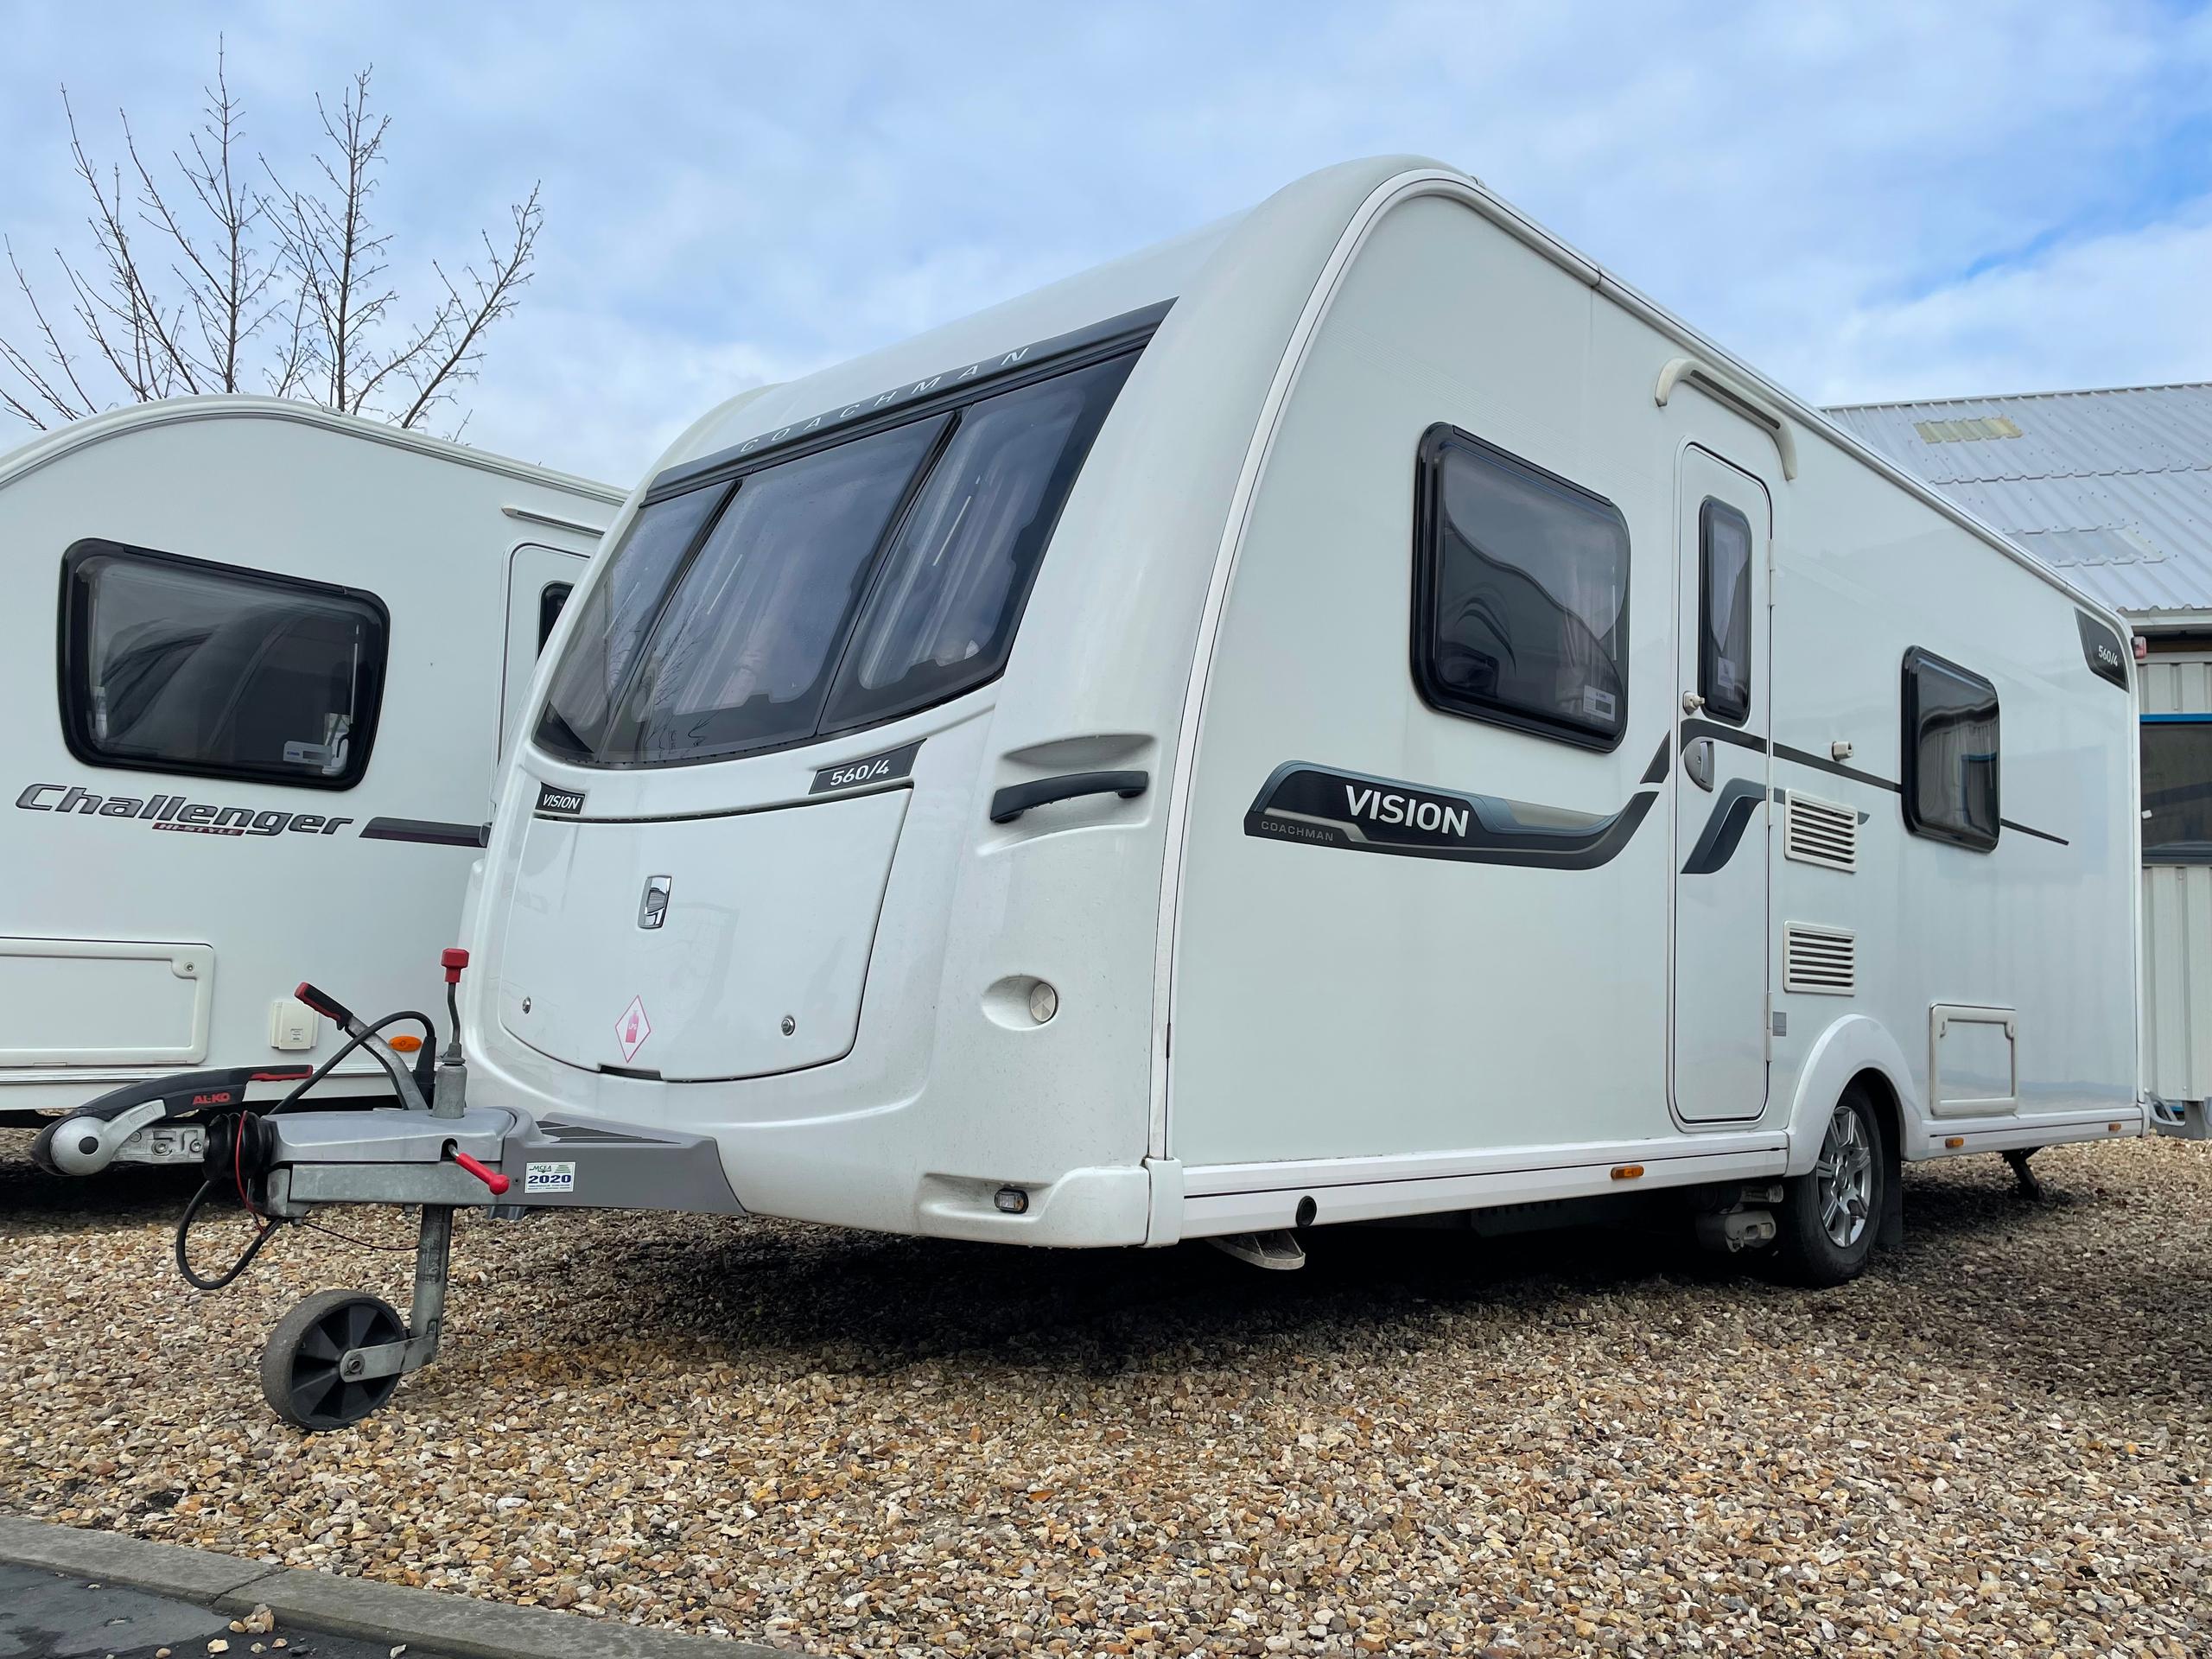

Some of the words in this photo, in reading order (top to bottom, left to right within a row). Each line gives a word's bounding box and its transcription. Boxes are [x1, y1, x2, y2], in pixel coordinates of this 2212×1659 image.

[739, 346, 1029, 453] COACHMAN
[2098, 645, 2118, 666] 560/4
[830, 760, 890, 785] 560/4
[15, 783, 354, 836] Challenger
[543, 794, 581, 810] VISION
[1345, 785, 1469, 837] VISION
[1261, 821, 1334, 842] COACHMAN
[528, 1174, 572, 1184] 2020
